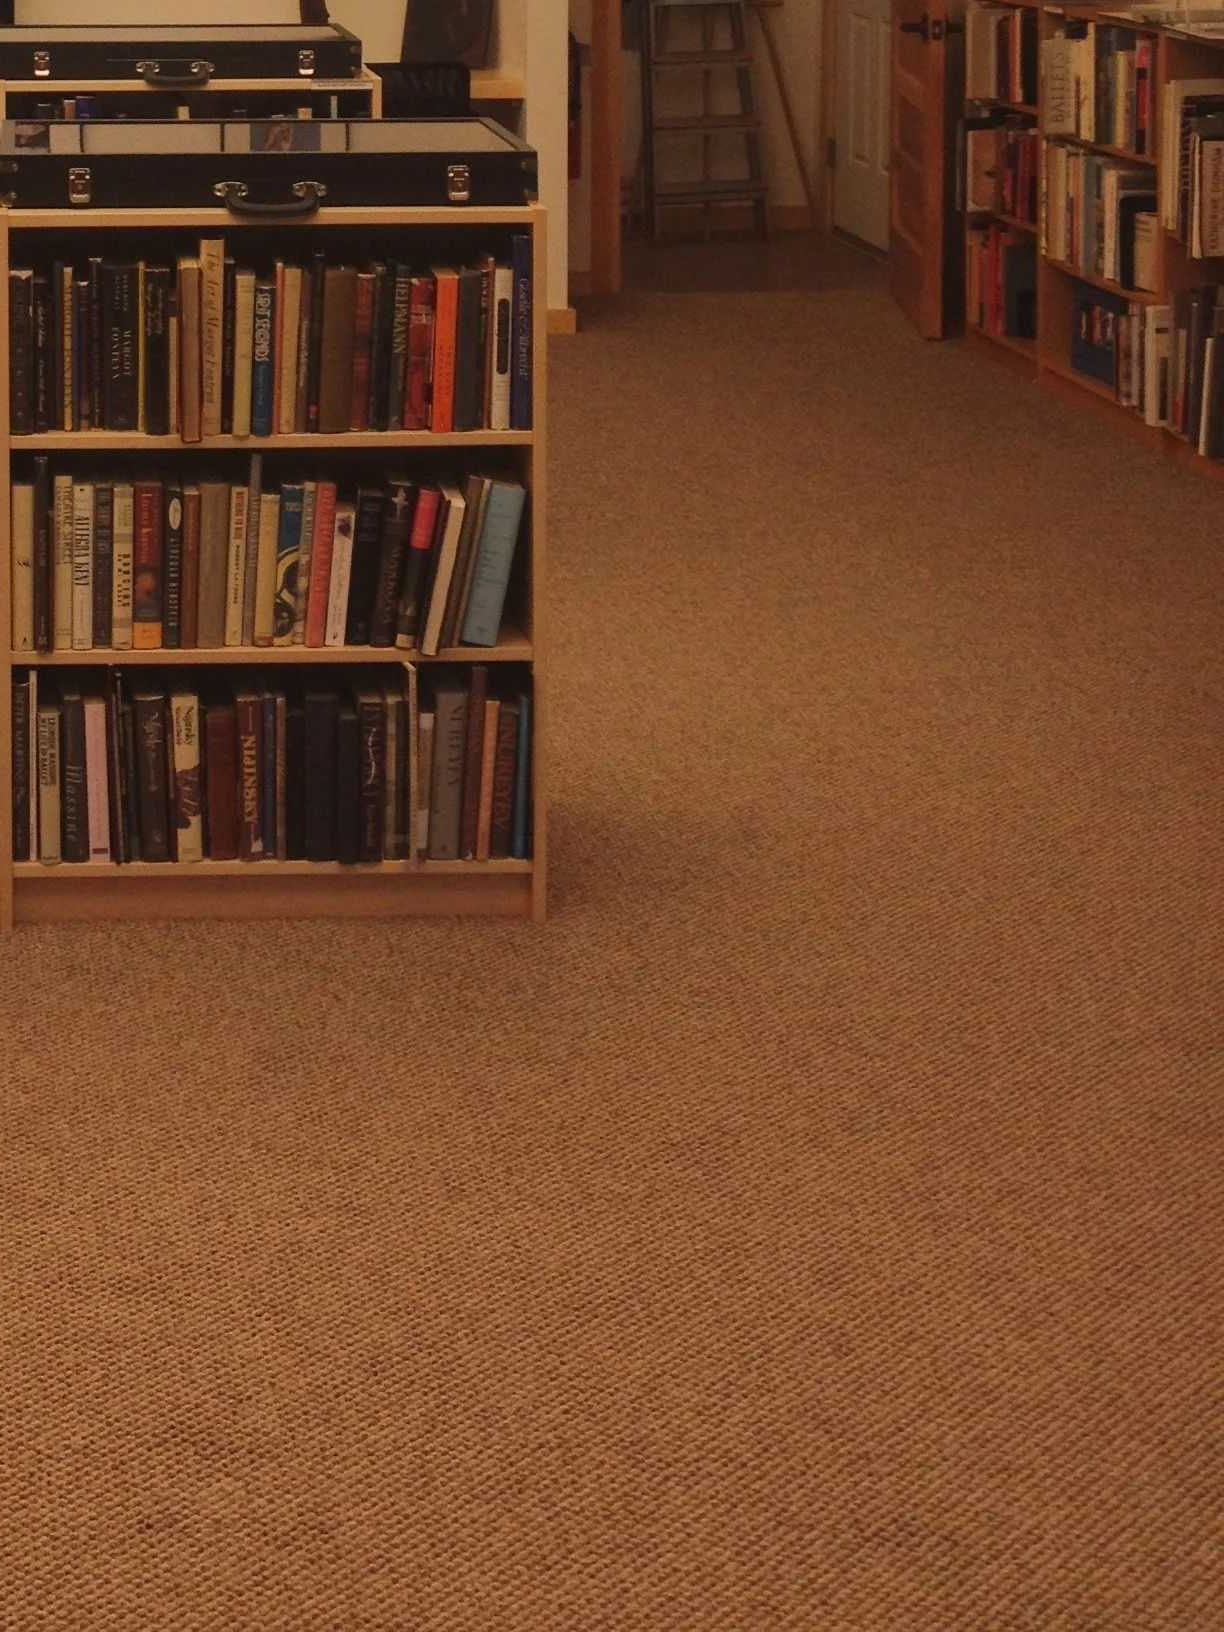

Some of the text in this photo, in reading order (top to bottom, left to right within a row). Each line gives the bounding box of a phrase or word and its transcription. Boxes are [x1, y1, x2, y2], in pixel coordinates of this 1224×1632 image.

[1048, 52, 1066, 123] BALLETS
[207, 252, 220, 272] The
[206, 279, 219, 298] Art
[392, 277, 410, 354] HELPMANN
[123, 330, 131, 377] MARGOT
[203, 317, 219, 358] Margot
[63, 485, 73, 526] THEATRE
[15, 693, 24, 724] PETER
[183, 706, 195, 746] Nijinsky
[243, 734, 257, 824] NIJINSKY
[65, 764, 83, 843] Massine
